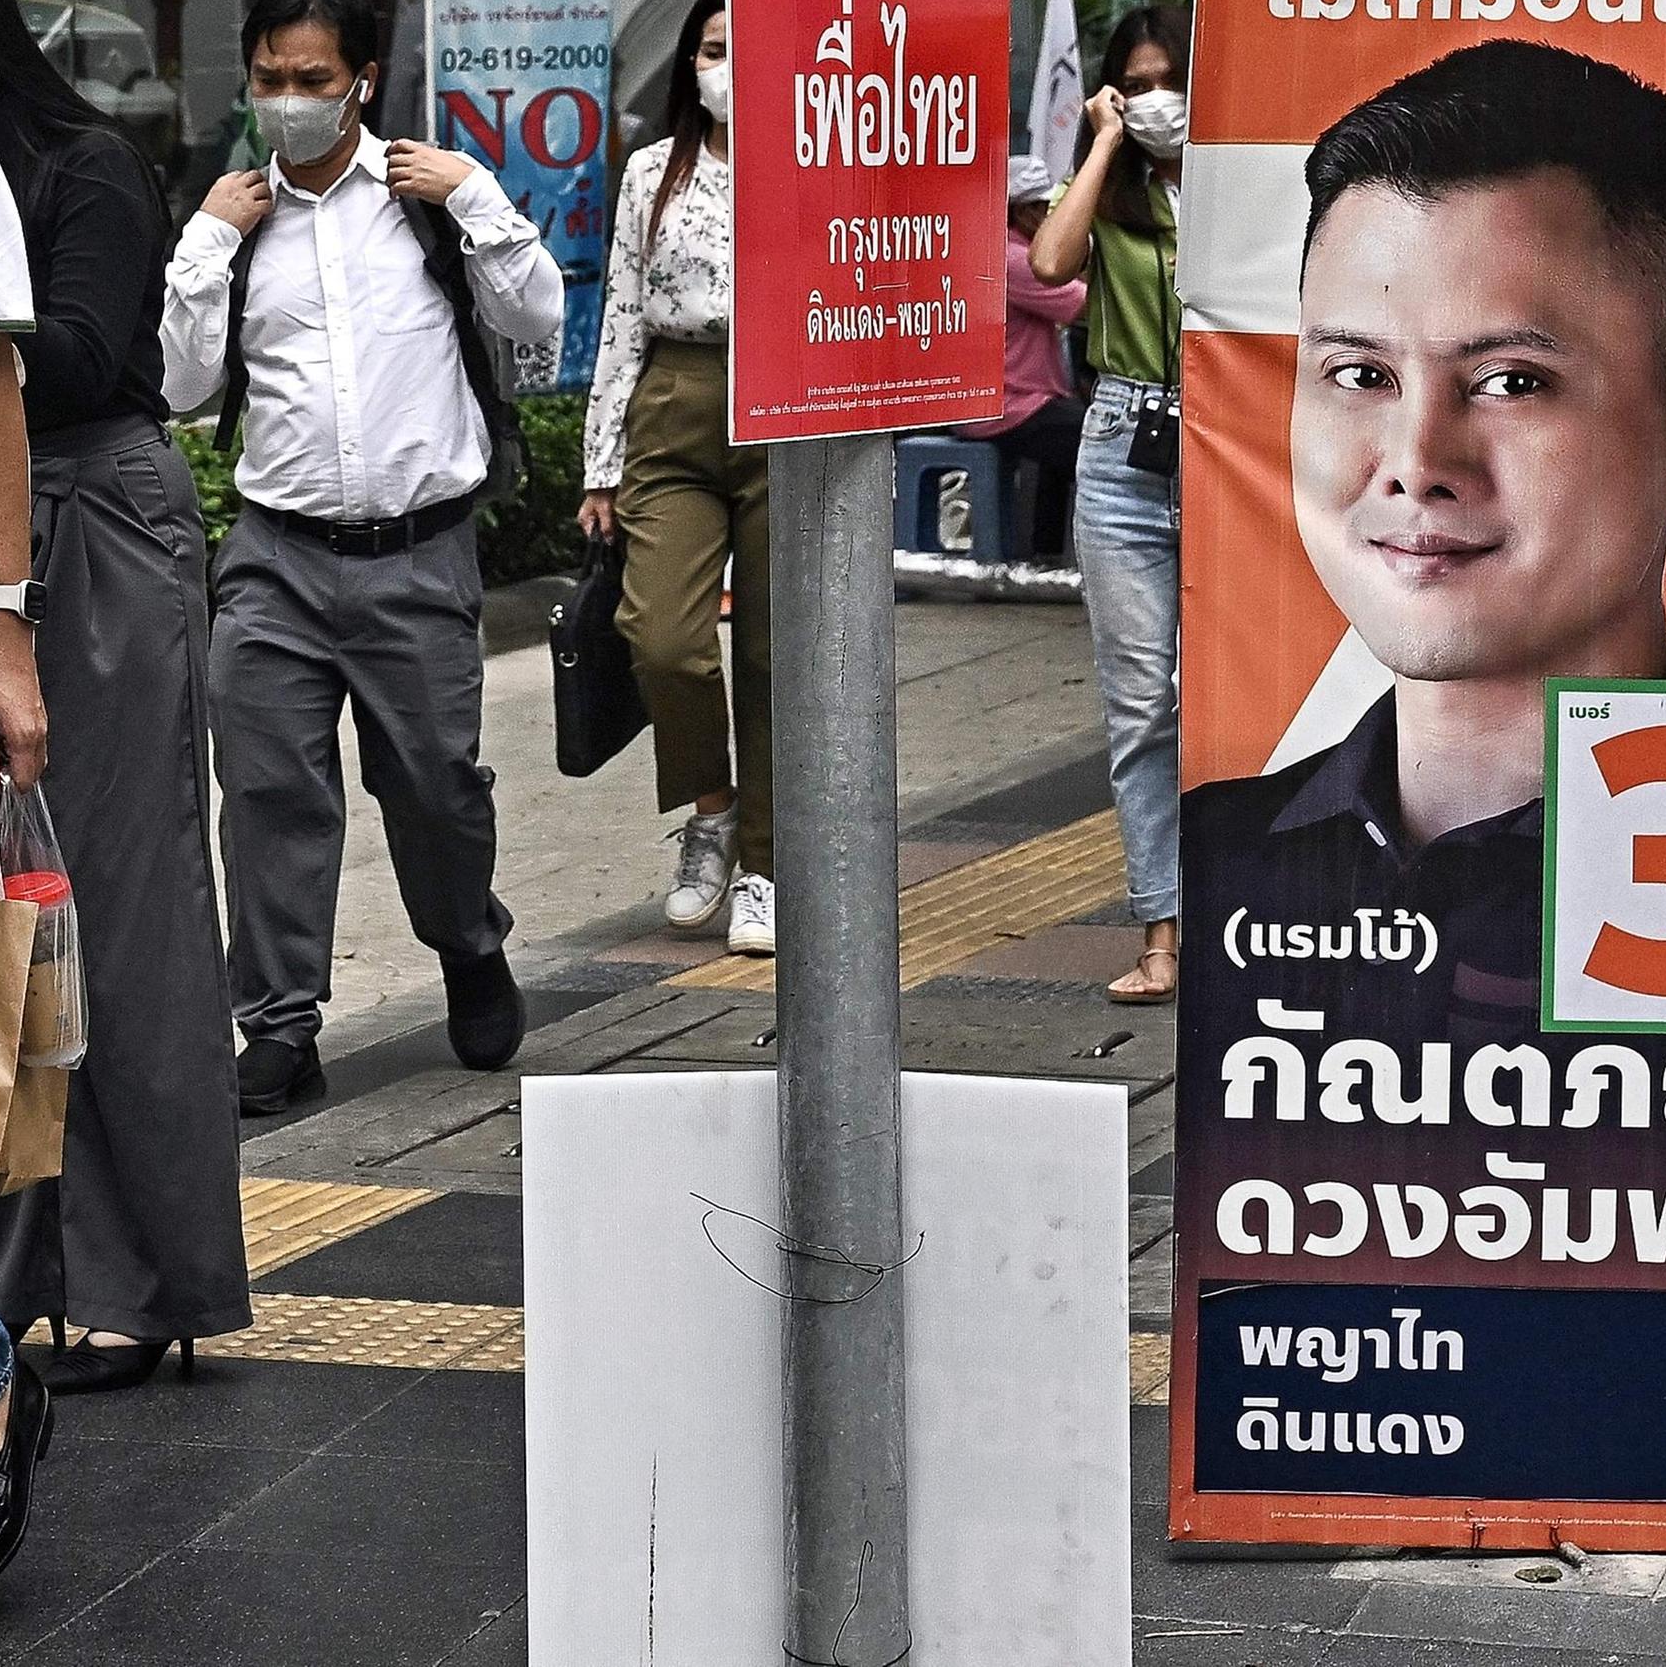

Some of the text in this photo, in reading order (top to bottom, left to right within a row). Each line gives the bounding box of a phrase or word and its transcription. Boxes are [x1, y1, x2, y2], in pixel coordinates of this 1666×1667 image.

[440, 44, 609, 73] 02-619-2000
[436, 86, 603, 170] NO
[827, 214, 951, 292] กรุงเทพฯ
[807, 275, 967, 352] ดินแดง-พญาไท
[1568, 700, 1611, 722] เบอร์
[1222, 907, 1439, 975] (แรมโบ้)
[1237, 1309, 1464, 1382] พญาไท
[1235, 1397, 1465, 1456] ดินแดง
